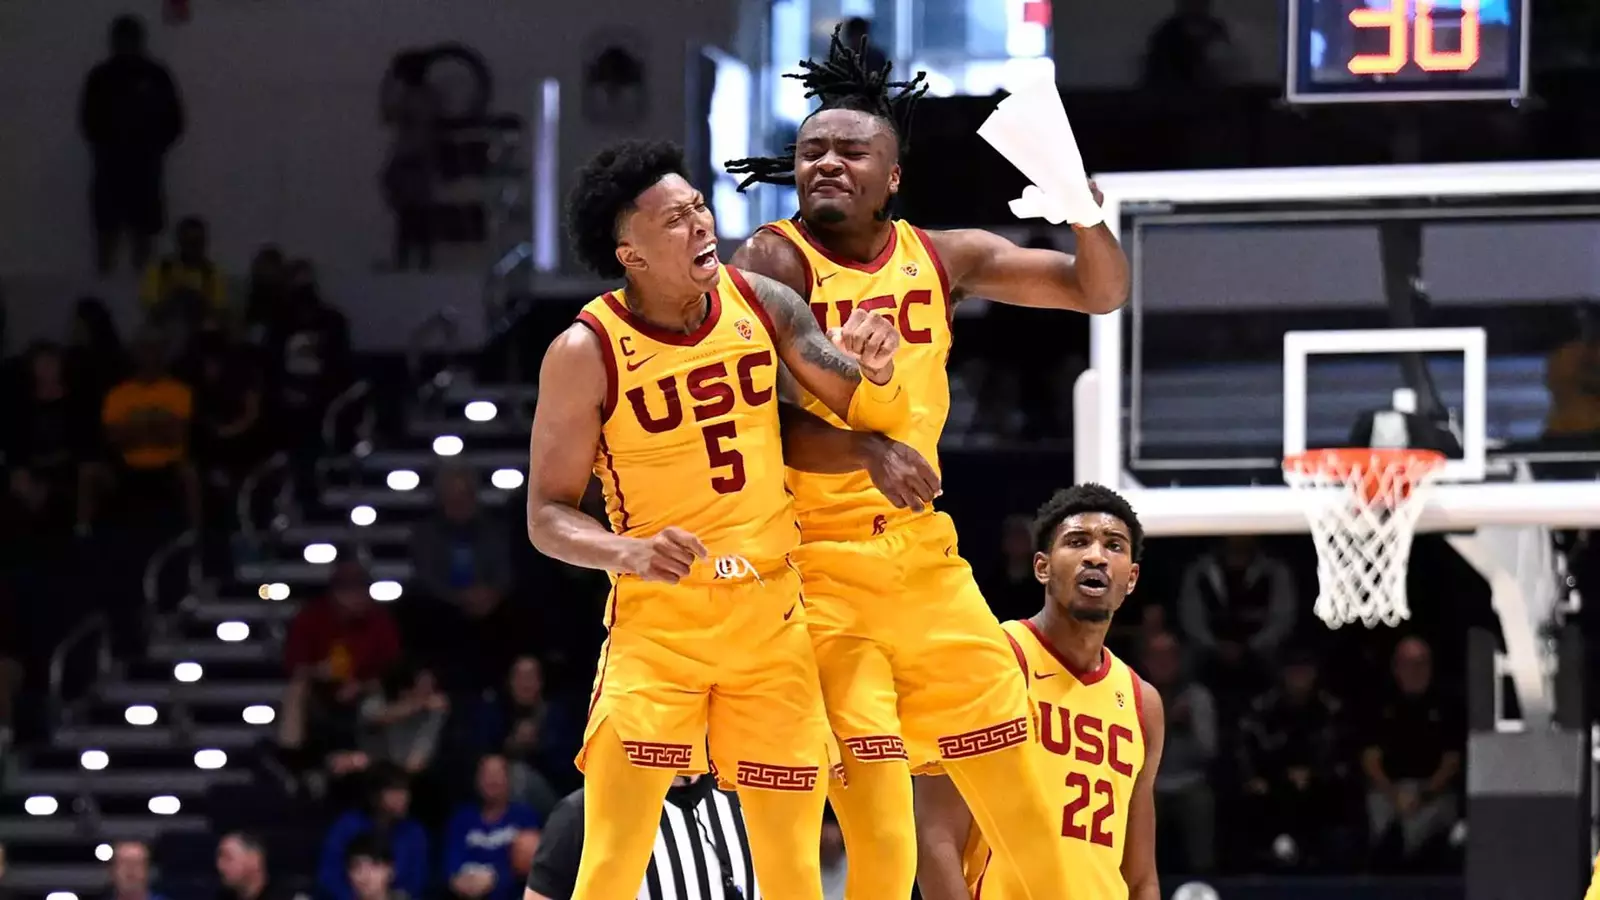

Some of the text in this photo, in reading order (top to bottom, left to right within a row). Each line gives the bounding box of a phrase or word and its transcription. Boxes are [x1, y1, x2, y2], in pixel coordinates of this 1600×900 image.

[1348, 0, 1480, 74] 30
[619, 337, 636, 357] C
[625, 350, 773, 433] USC
[702, 420, 746, 494] 5
[1038, 701, 1134, 778] USC
[1061, 771, 1115, 848] 22
